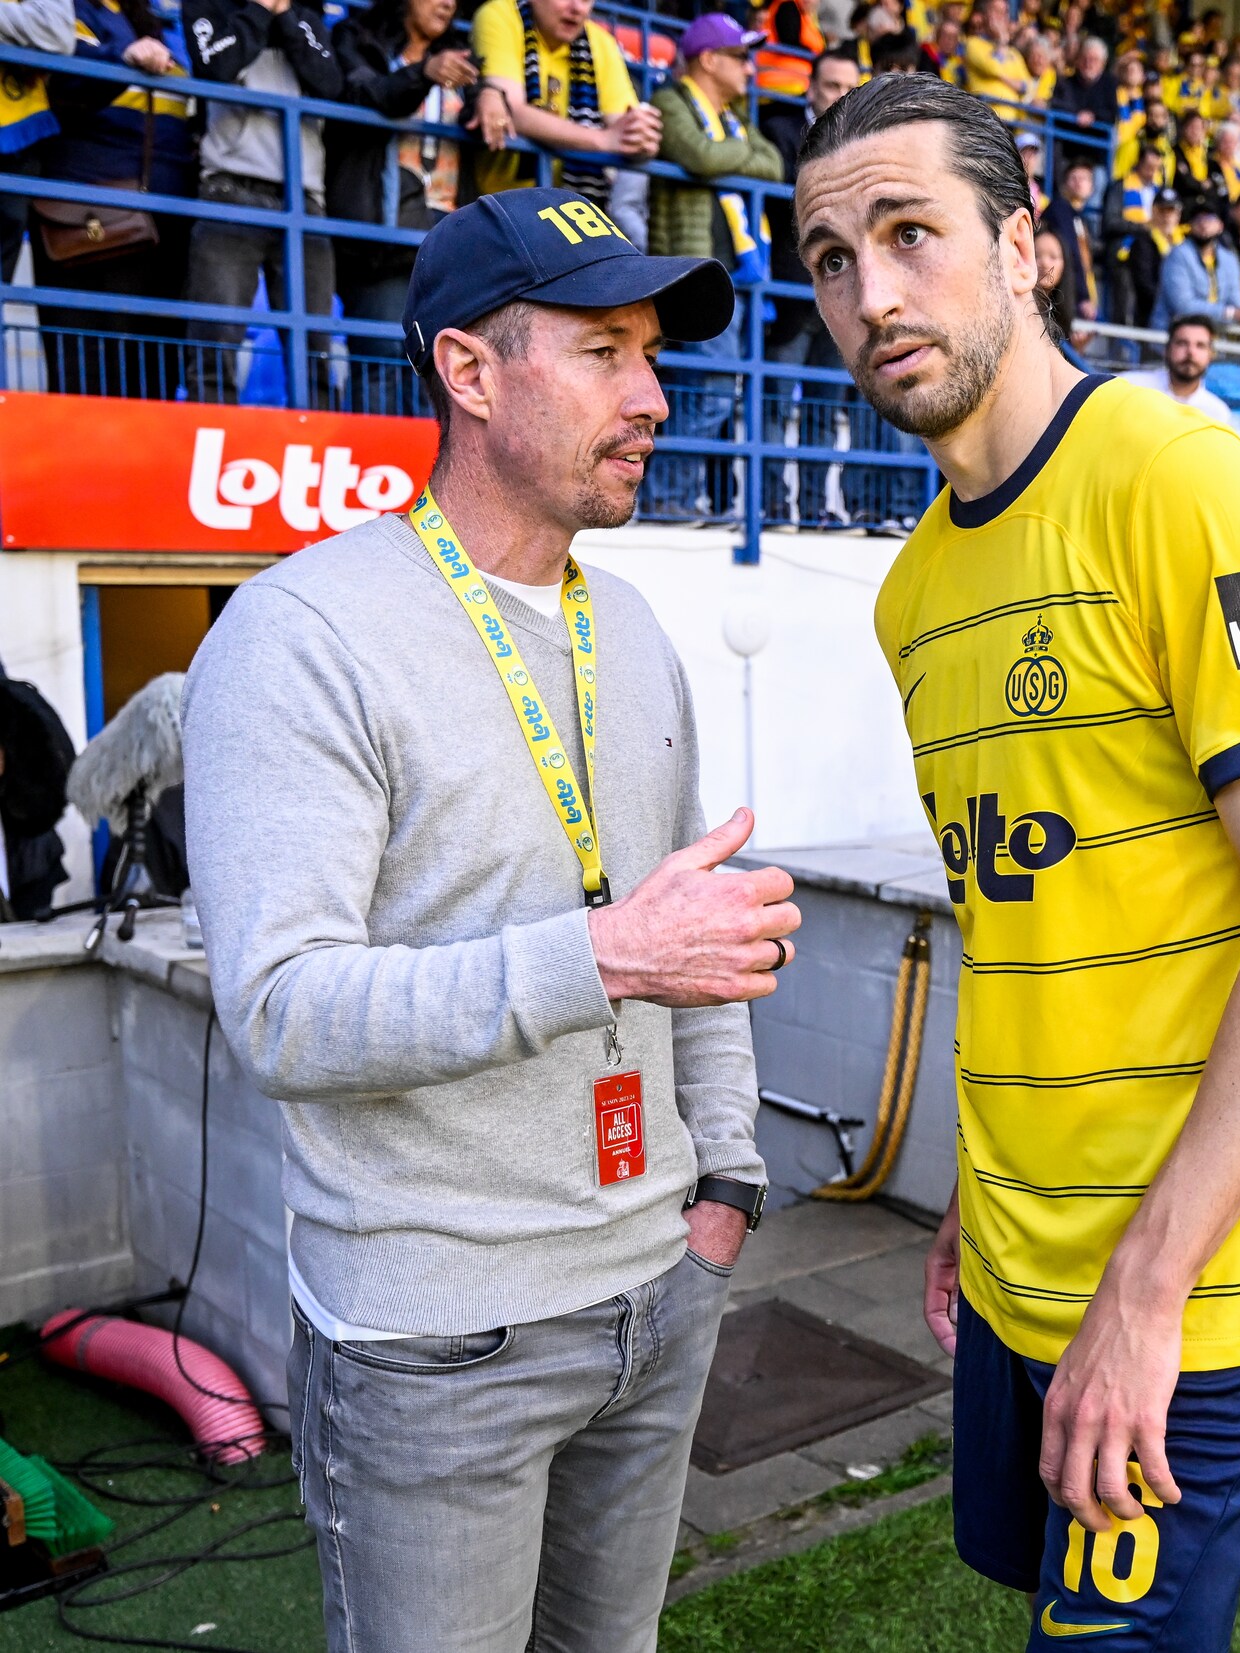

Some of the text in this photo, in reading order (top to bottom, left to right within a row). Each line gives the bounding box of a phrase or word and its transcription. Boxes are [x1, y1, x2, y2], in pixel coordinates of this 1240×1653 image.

[537, 201, 633, 246] 18
[1011, 670, 1060, 702] USG
[607, 1123, 633, 1142] ACCESS
[613, 1111, 626, 1127] ALL
[1064, 1459, 1164, 1603] 16
